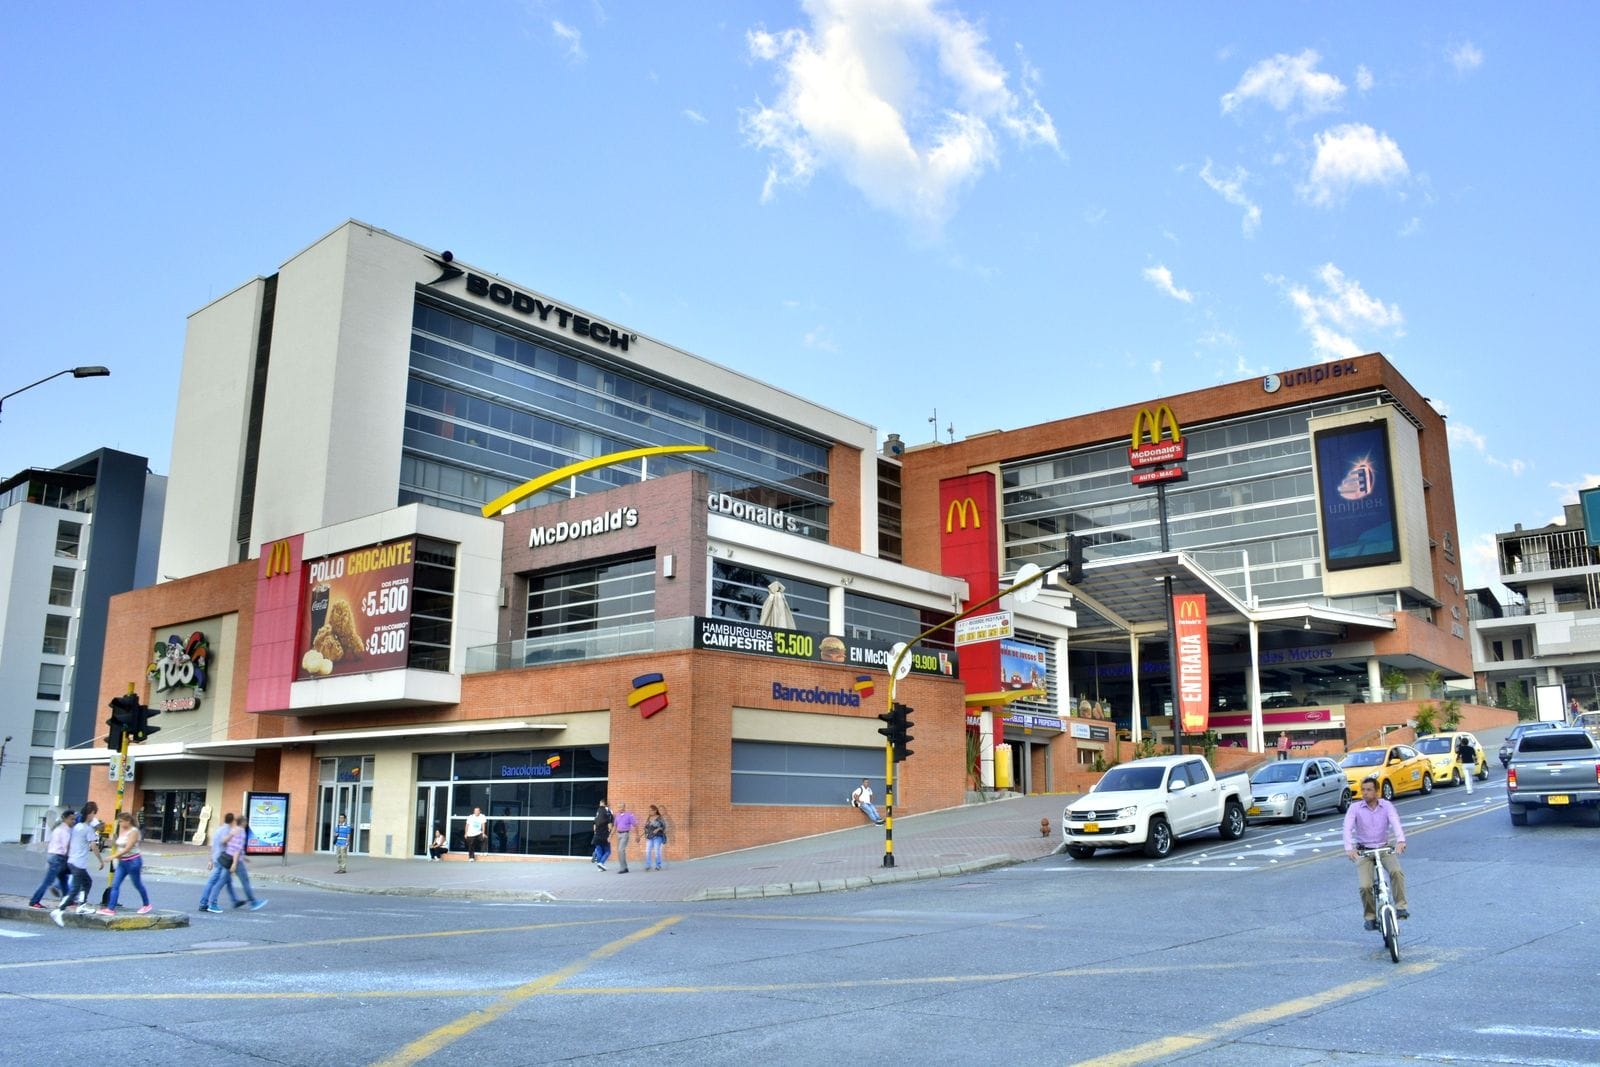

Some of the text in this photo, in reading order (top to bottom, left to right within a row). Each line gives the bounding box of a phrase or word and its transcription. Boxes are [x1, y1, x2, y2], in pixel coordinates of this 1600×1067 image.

[466, 271, 629, 350] BODYTECH
[1131, 445, 1181, 459] McDonald's
[707, 492, 798, 533] cDonald's
[529, 506, 639, 548] McDonald's
[309, 541, 413, 584] POLLO CROCANTE
[361, 585, 409, 617] $5.500
[365, 629, 405, 656] $9.900
[702, 622, 773, 640] HAMBURGUESA
[702, 631, 774, 653] CAMPESTRE
[774, 631, 813, 657] $5.500
[850, 647, 862, 662] EN
[1180, 634, 1203, 702] ENTRADA
[772, 682, 860, 707] Bancolombia
[501, 763, 552, 778] Bancolombia
